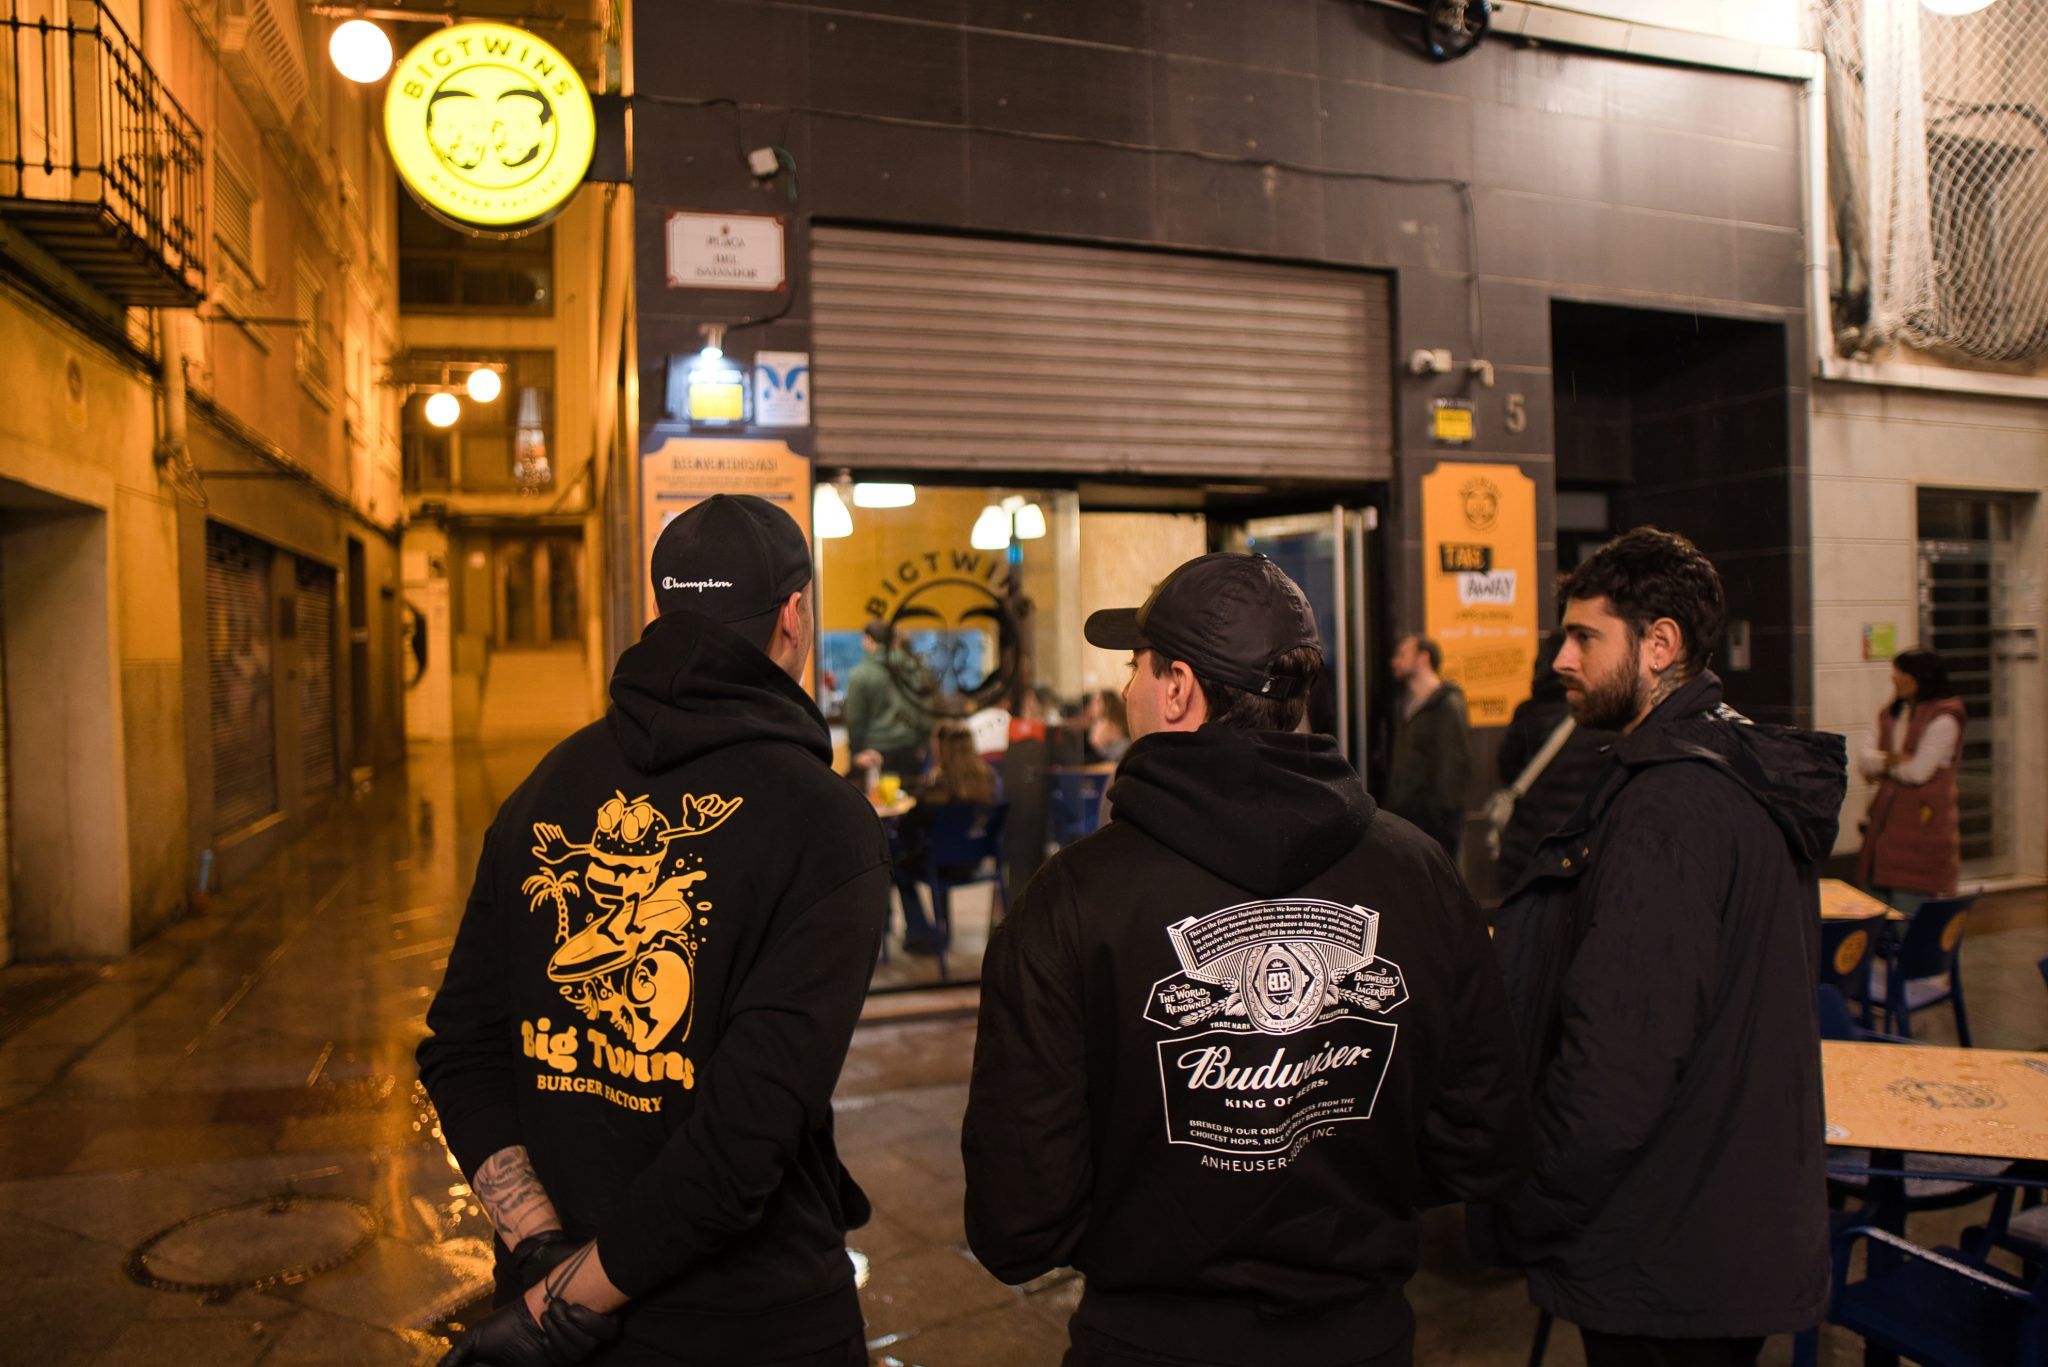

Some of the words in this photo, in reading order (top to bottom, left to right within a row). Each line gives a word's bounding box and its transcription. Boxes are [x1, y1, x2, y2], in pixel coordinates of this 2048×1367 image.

[402, 36, 573, 99] BIGTWINS
[1506, 393, 1526, 432] 5
[662, 576, 733, 593] Champion
[1189, 929, 1202, 938] This
[1216, 914, 1238, 926] famous
[1320, 907, 1338, 916] brand
[1201, 933, 1213, 941] any
[1213, 925, 1229, 935] other
[1311, 913, 1328, 921] brew
[1351, 924, 1363, 933] Our
[1196, 936, 1223, 953] exclusive
[1269, 921, 1298, 929] produces
[1328, 925, 1362, 940] smoothness
[1200, 951, 1212, 960] and
[1354, 972, 1394, 985] BUDWEISER
[1356, 982, 1380, 997] LAGER
[1380, 987, 1395, 997] BEER
[1158, 993, 1176, 1004] THE
[1175, 988, 1209, 1000] WORLD
[1165, 998, 1211, 1015] RENOWNED
[1210, 1021, 1231, 1029] TRADE
[1231, 1022, 1251, 1030] MARK
[521, 1016, 579, 1073] Big
[587, 1027, 695, 1090] Twins
[1177, 1041, 1372, 1090] Budweiser
[537, 1074, 603, 1096] BURGER
[604, 1085, 663, 1113] FACTORY
[1225, 1098, 1267, 1109] KING
[1274, 1095, 1294, 1107] OF
[1189, 1119, 1222, 1131] BREWED
[1223, 1126, 1234, 1134] BY
[1318, 1099, 1339, 1108] FROM
[1189, 1129, 1228, 1143] CHOICEST
[1230, 1137, 1261, 1146] HOPS,
[1263, 1134, 1285, 1146] RICE
[1305, 1110, 1331, 1121] BARLEY
[1332, 1106, 1354, 1114] MALT
[1312, 1126, 1336, 1140] INC.
